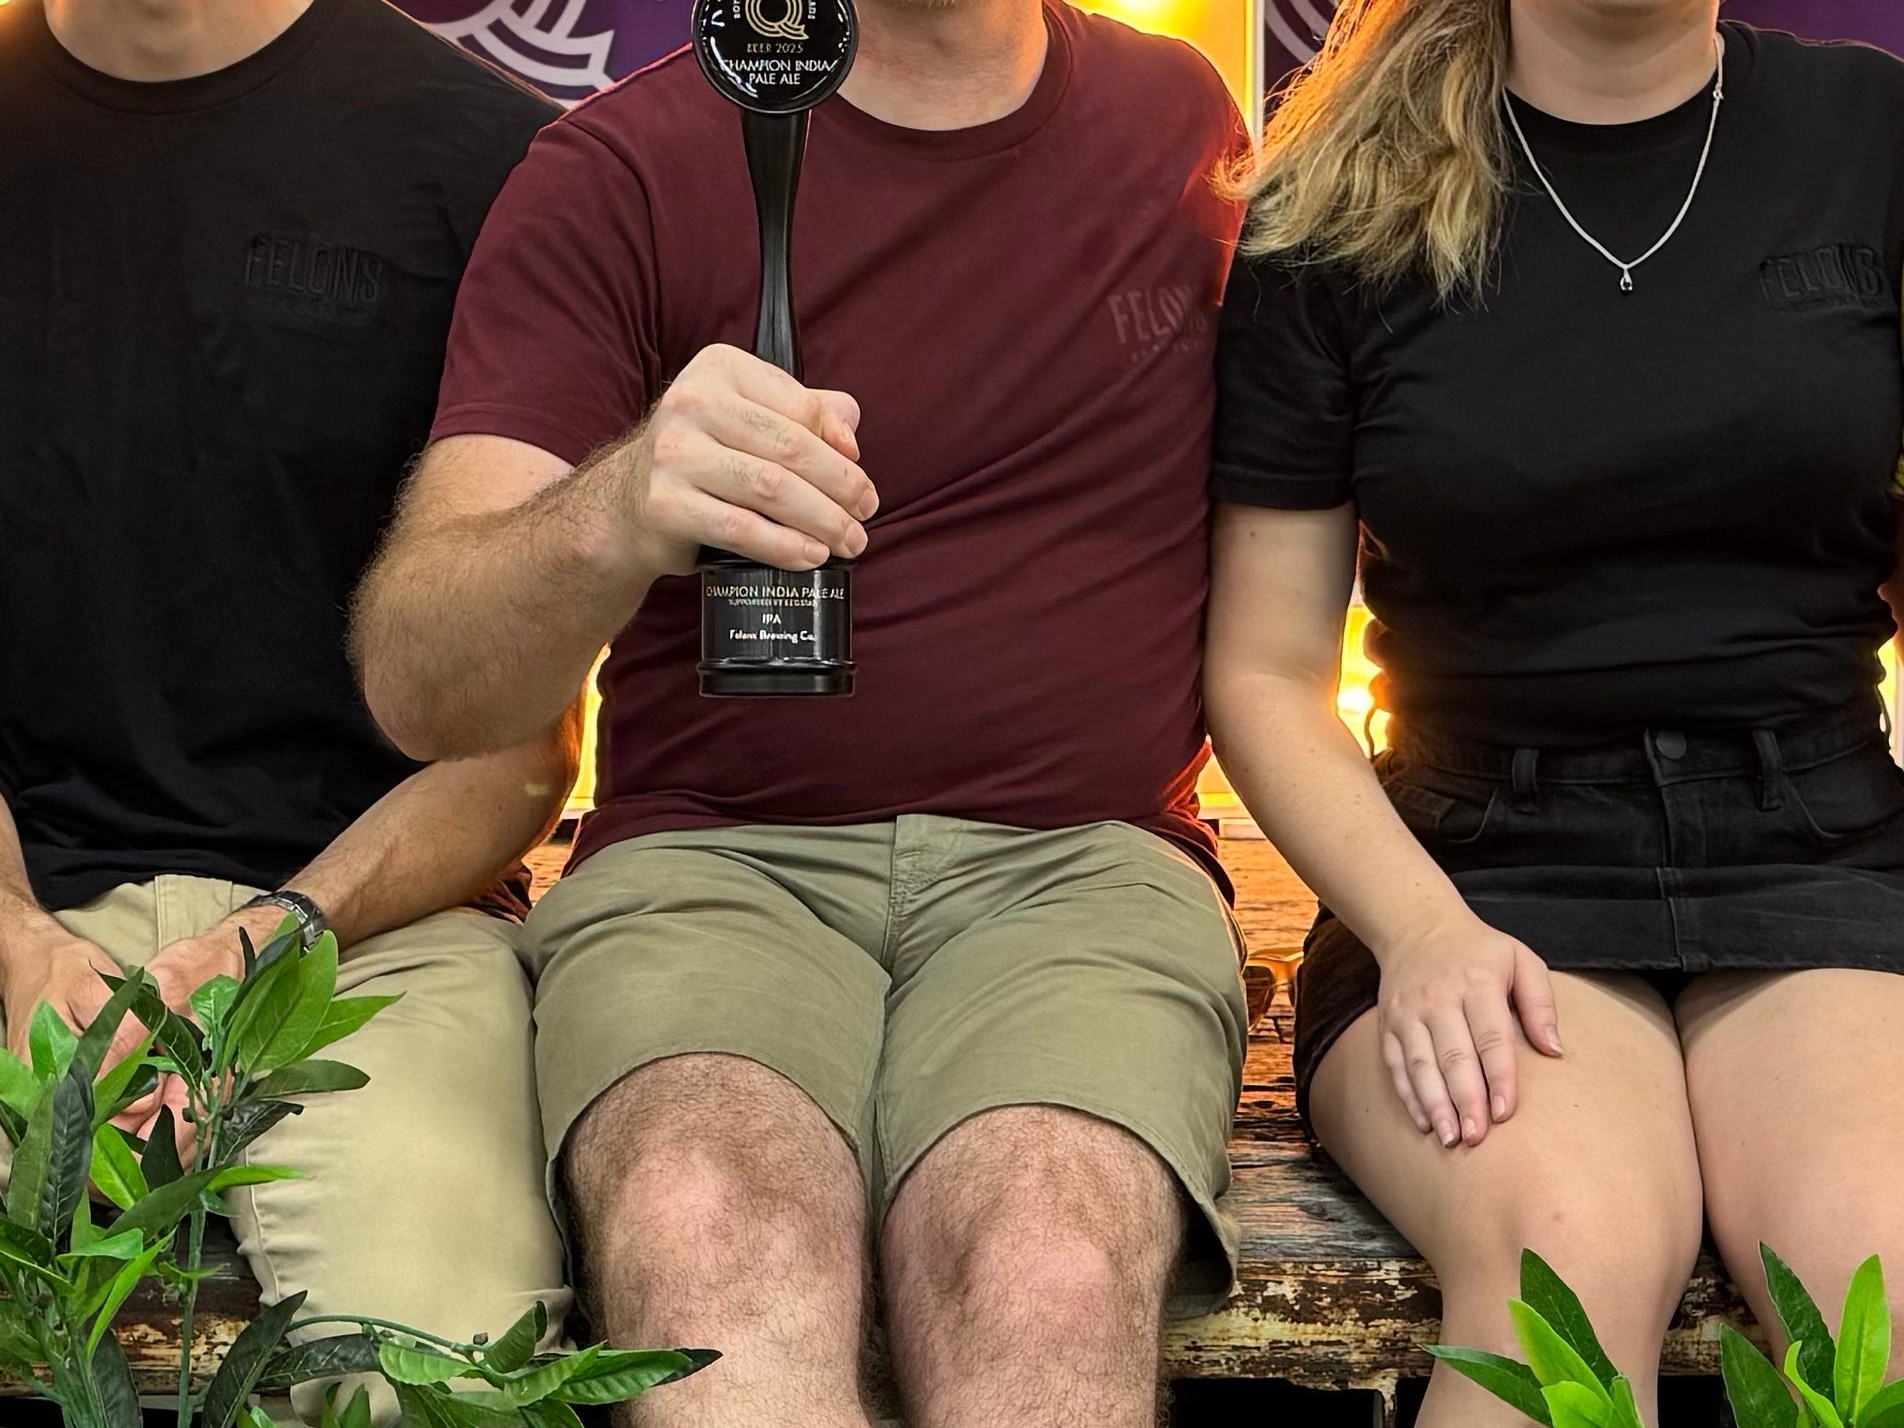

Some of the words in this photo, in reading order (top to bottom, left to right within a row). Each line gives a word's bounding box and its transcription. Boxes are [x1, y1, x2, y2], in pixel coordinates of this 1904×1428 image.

[748, 72, 777, 86] PALE
[779, 72, 802, 86] ALE
[245, 235, 384, 303] FELONS
[761, 585, 800, 598] INDIA
[761, 613, 783, 626] IPA
